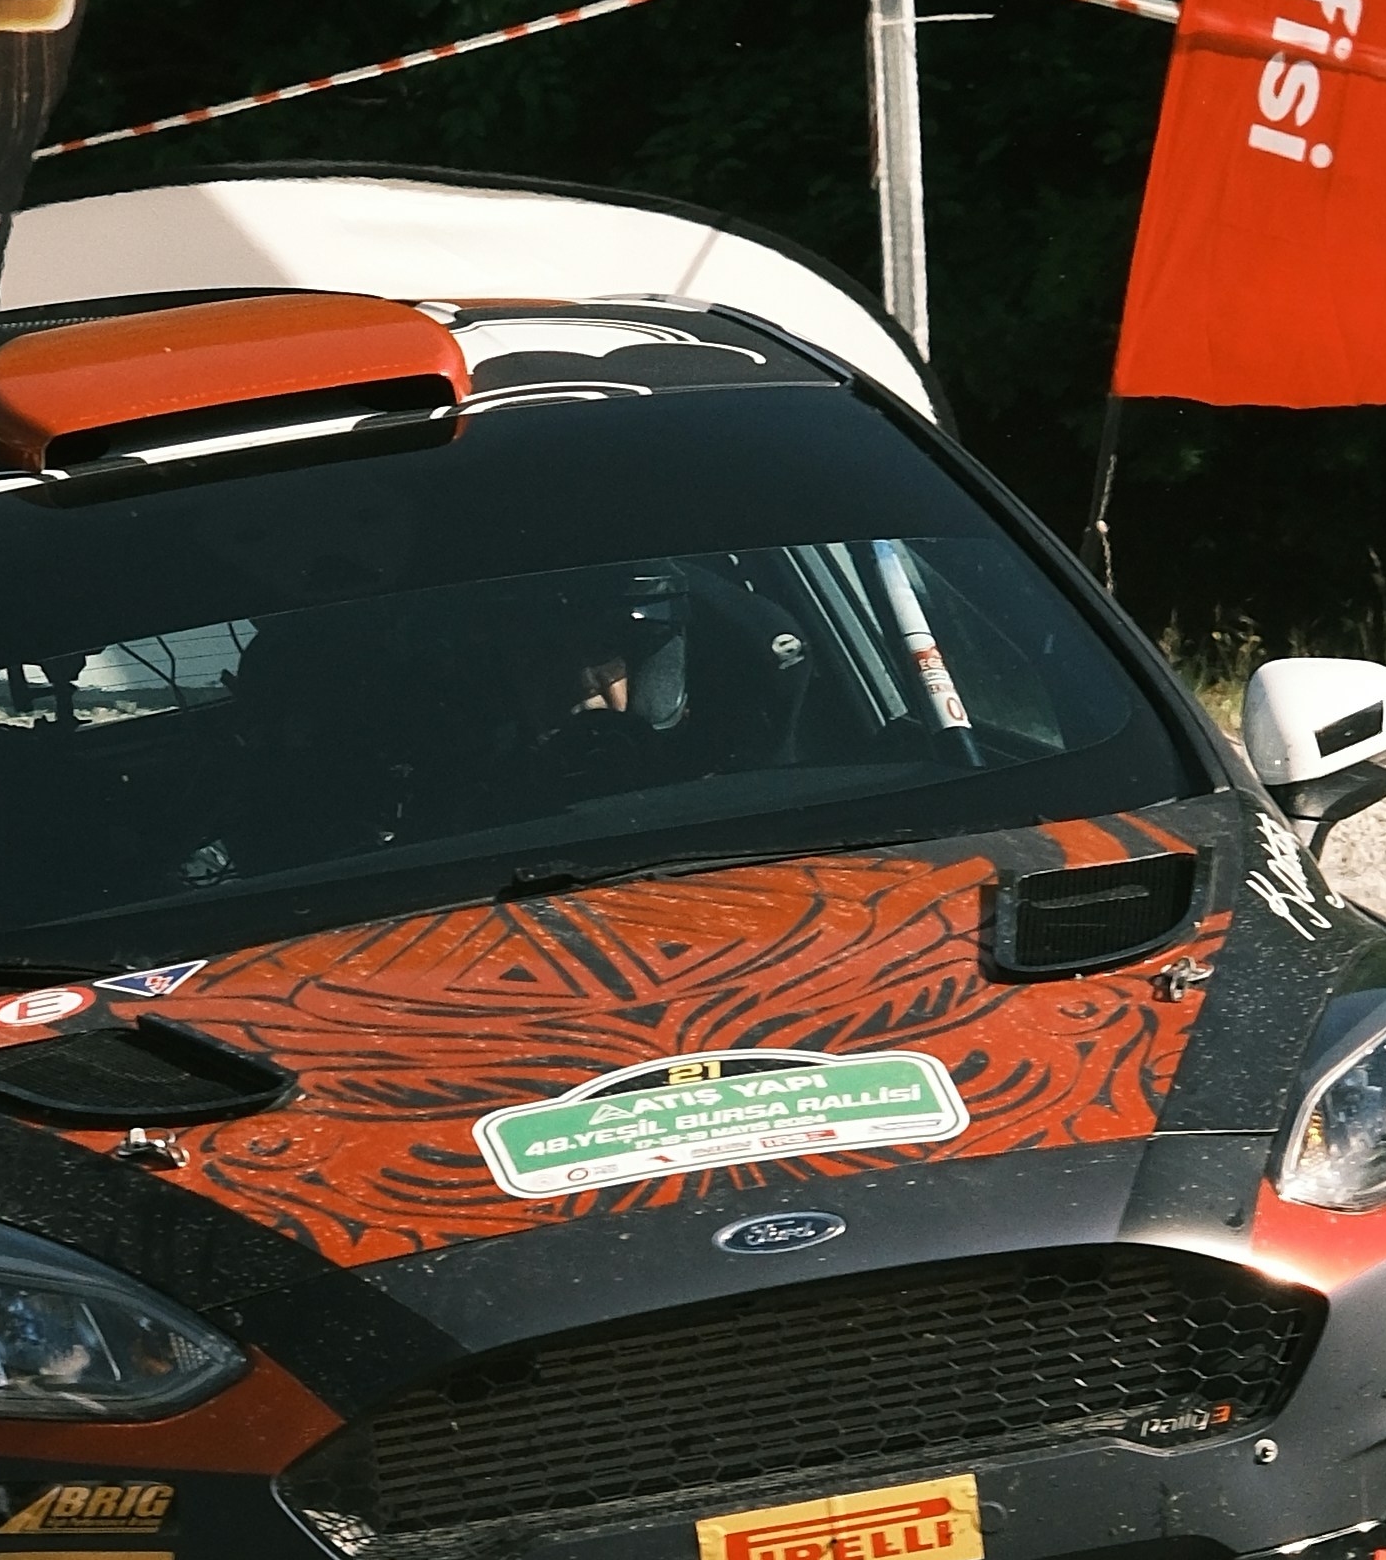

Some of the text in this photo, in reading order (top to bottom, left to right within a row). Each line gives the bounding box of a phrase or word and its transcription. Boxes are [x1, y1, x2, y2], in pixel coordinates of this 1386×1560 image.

[668, 1060, 721, 1085] 21
[631, 1073, 829, 1115] ATIŞ YAPI
[675, 1102, 790, 1130] BURSA
[796, 1083, 922, 1114] RALLİSİ
